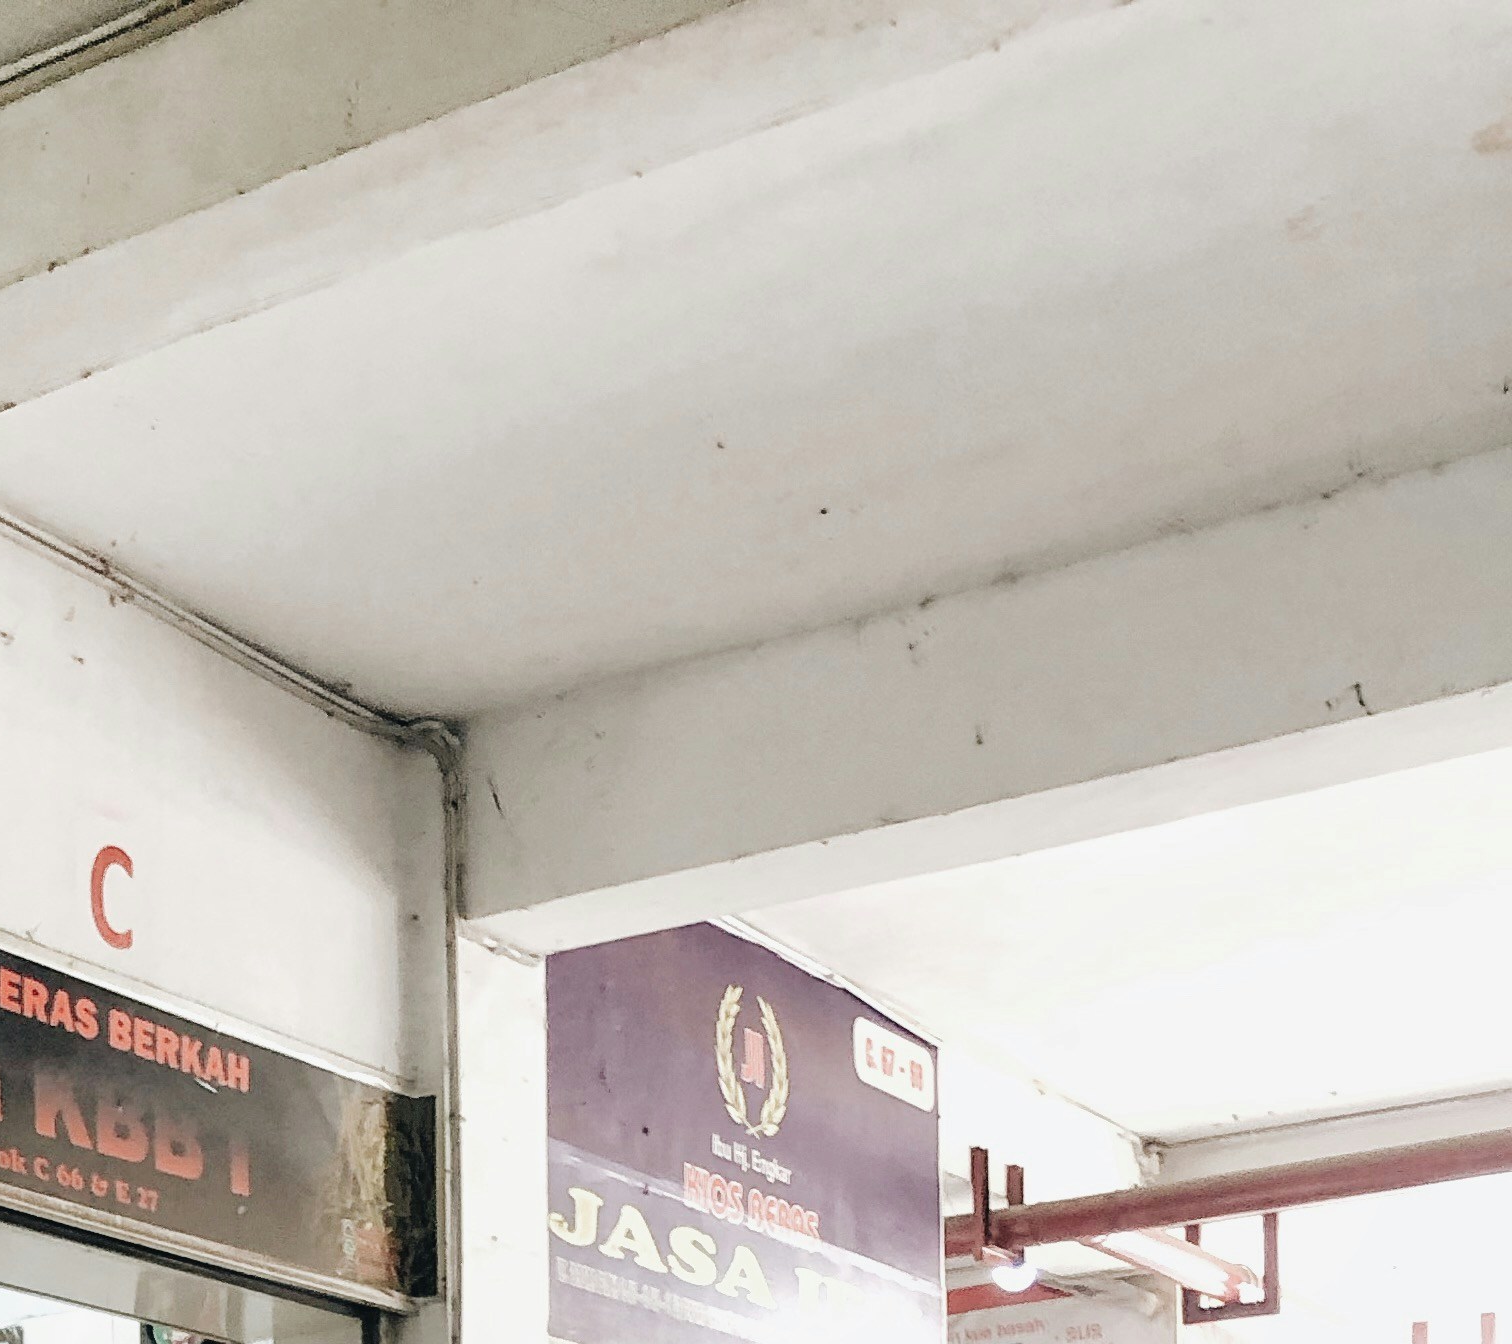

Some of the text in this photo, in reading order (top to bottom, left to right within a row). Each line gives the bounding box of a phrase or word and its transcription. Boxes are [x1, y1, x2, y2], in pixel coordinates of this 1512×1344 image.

[89, 845, 134, 949] C
[107, 1008, 250, 1093] BERKAH
[33, 1065, 204, 1180] KBB
[33, 1156, 51, 1181] C
[56, 1162, 85, 1191] 66
[548, 1187, 778, 1310] JASA
